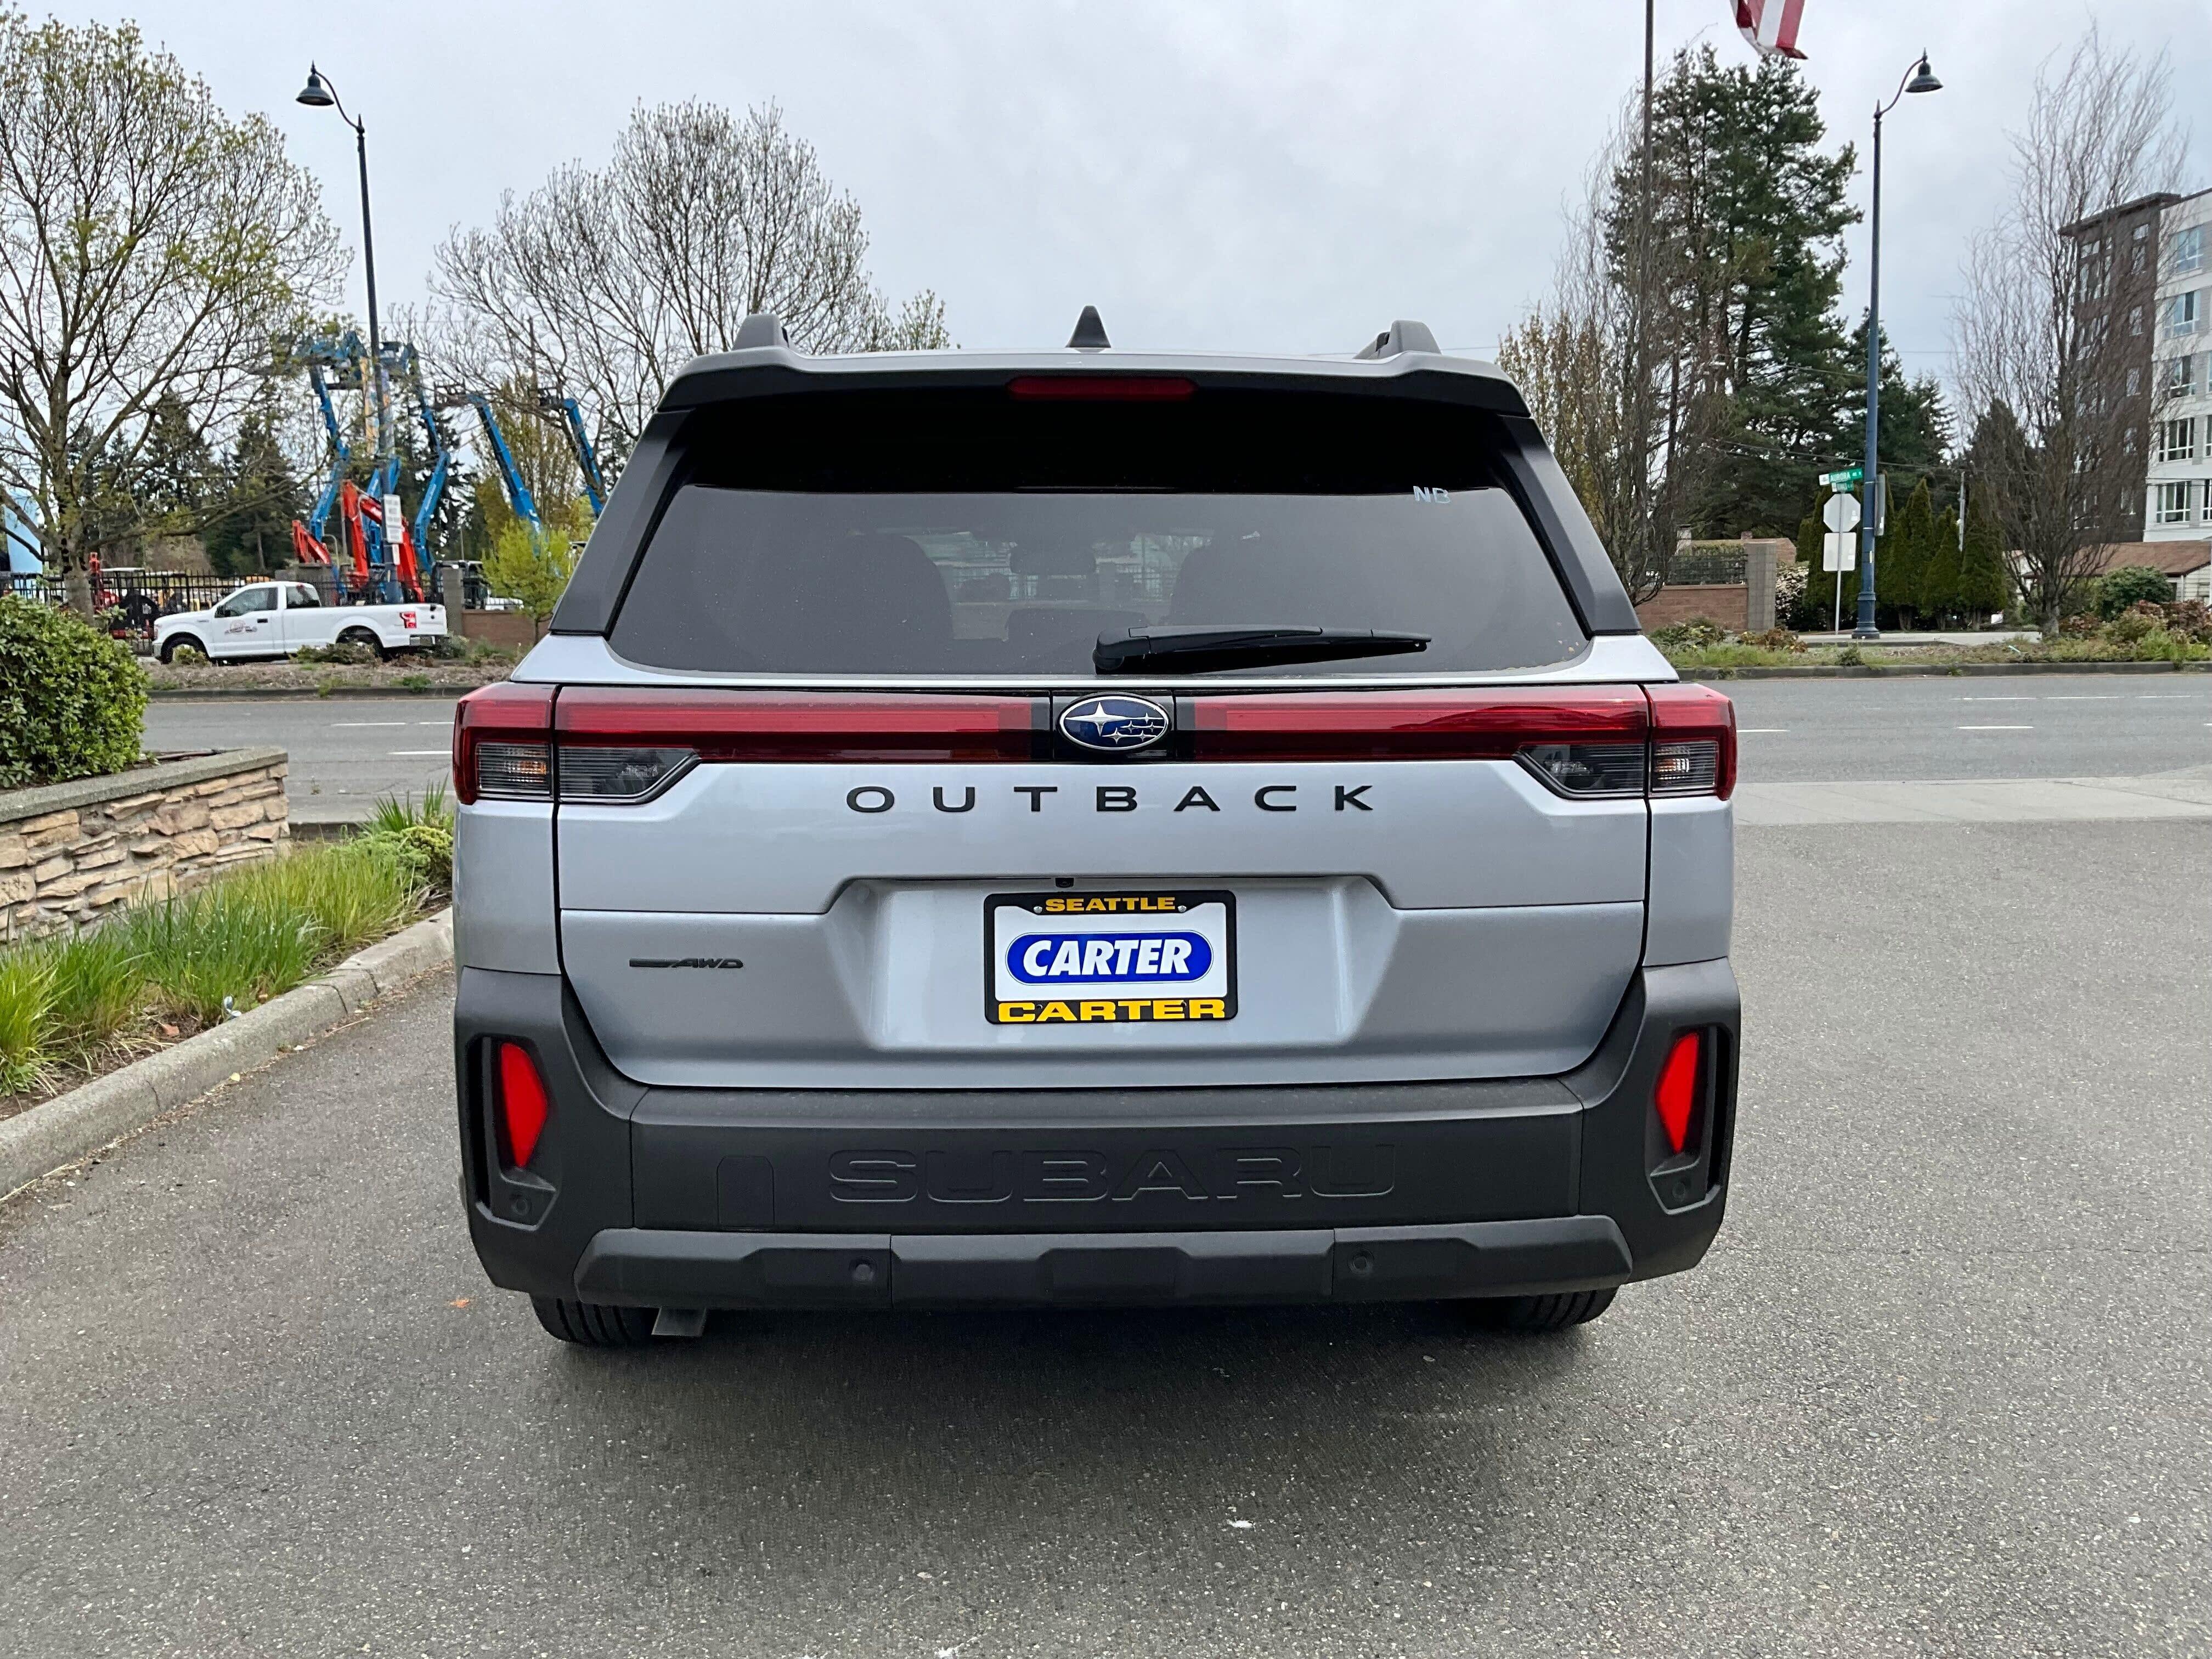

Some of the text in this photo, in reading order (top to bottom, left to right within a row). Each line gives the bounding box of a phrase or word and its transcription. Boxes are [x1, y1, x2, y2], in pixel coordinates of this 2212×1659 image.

[845, 785, 1373, 813] OUTBACK
[1046, 897, 1175, 911] SEATTLE
[672, 958, 743, 968] AWD
[1023, 939, 1192, 976] CARTER
[998, 999, 1225, 1023] CARTER
[828, 1146, 1396, 1204] SUBARU
